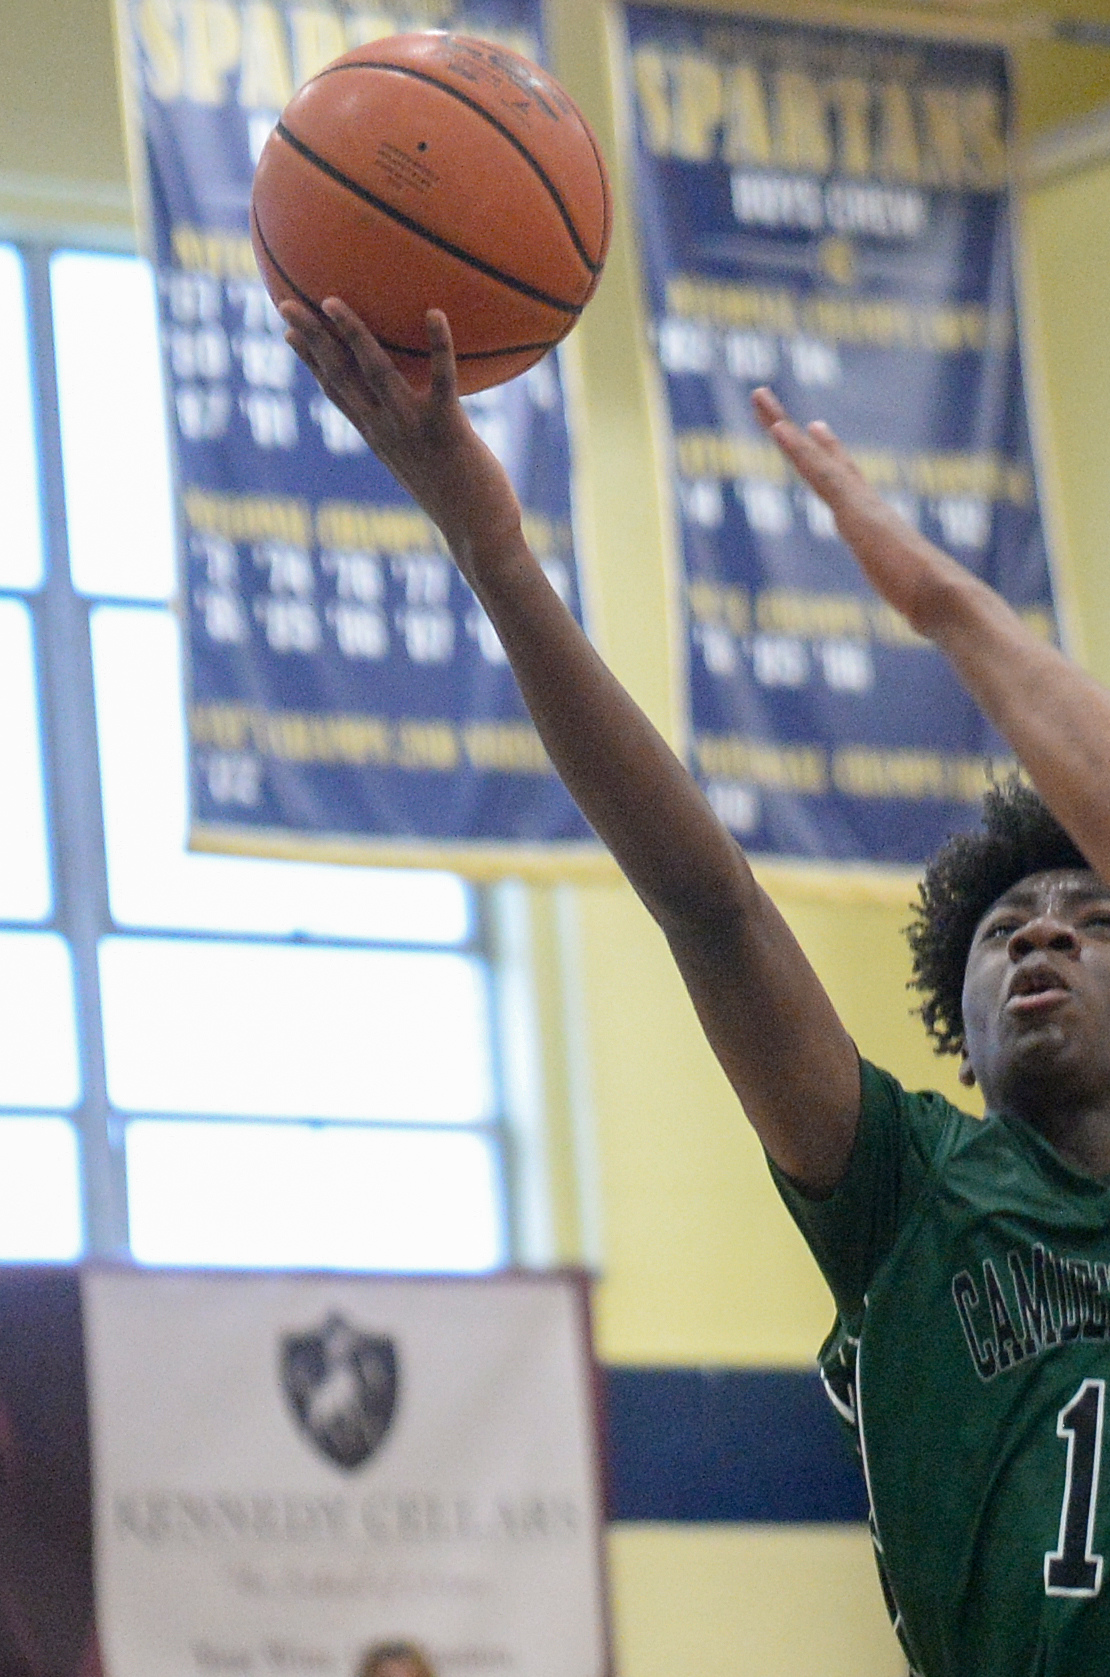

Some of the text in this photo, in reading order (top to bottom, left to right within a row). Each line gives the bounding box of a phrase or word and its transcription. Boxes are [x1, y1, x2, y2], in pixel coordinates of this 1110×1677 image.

[636, 46, 1010, 190] SPARTANS
[114, 1488, 579, 1546] KENNEDY CELLARS
